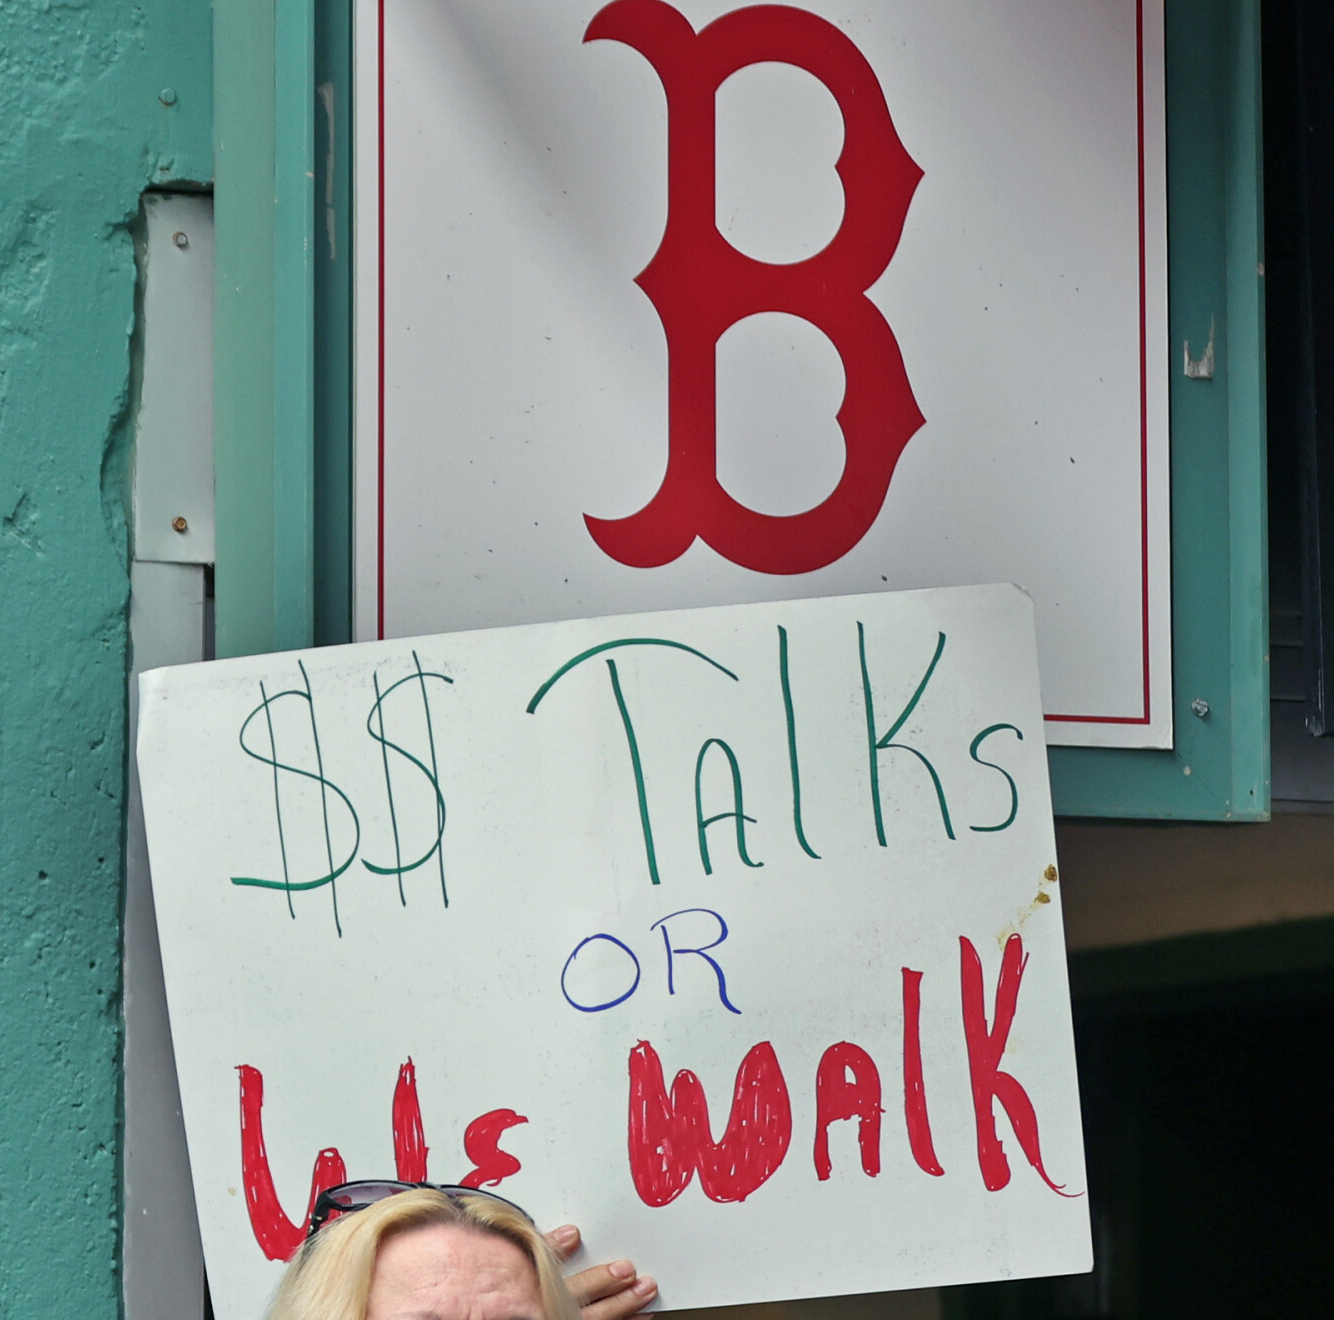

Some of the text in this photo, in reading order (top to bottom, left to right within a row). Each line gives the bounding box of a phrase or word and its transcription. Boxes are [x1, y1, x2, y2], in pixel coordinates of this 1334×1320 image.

[582, 0, 926, 575] B
[230, 650, 454, 937] $$
[560, 908, 742, 1015] OR
